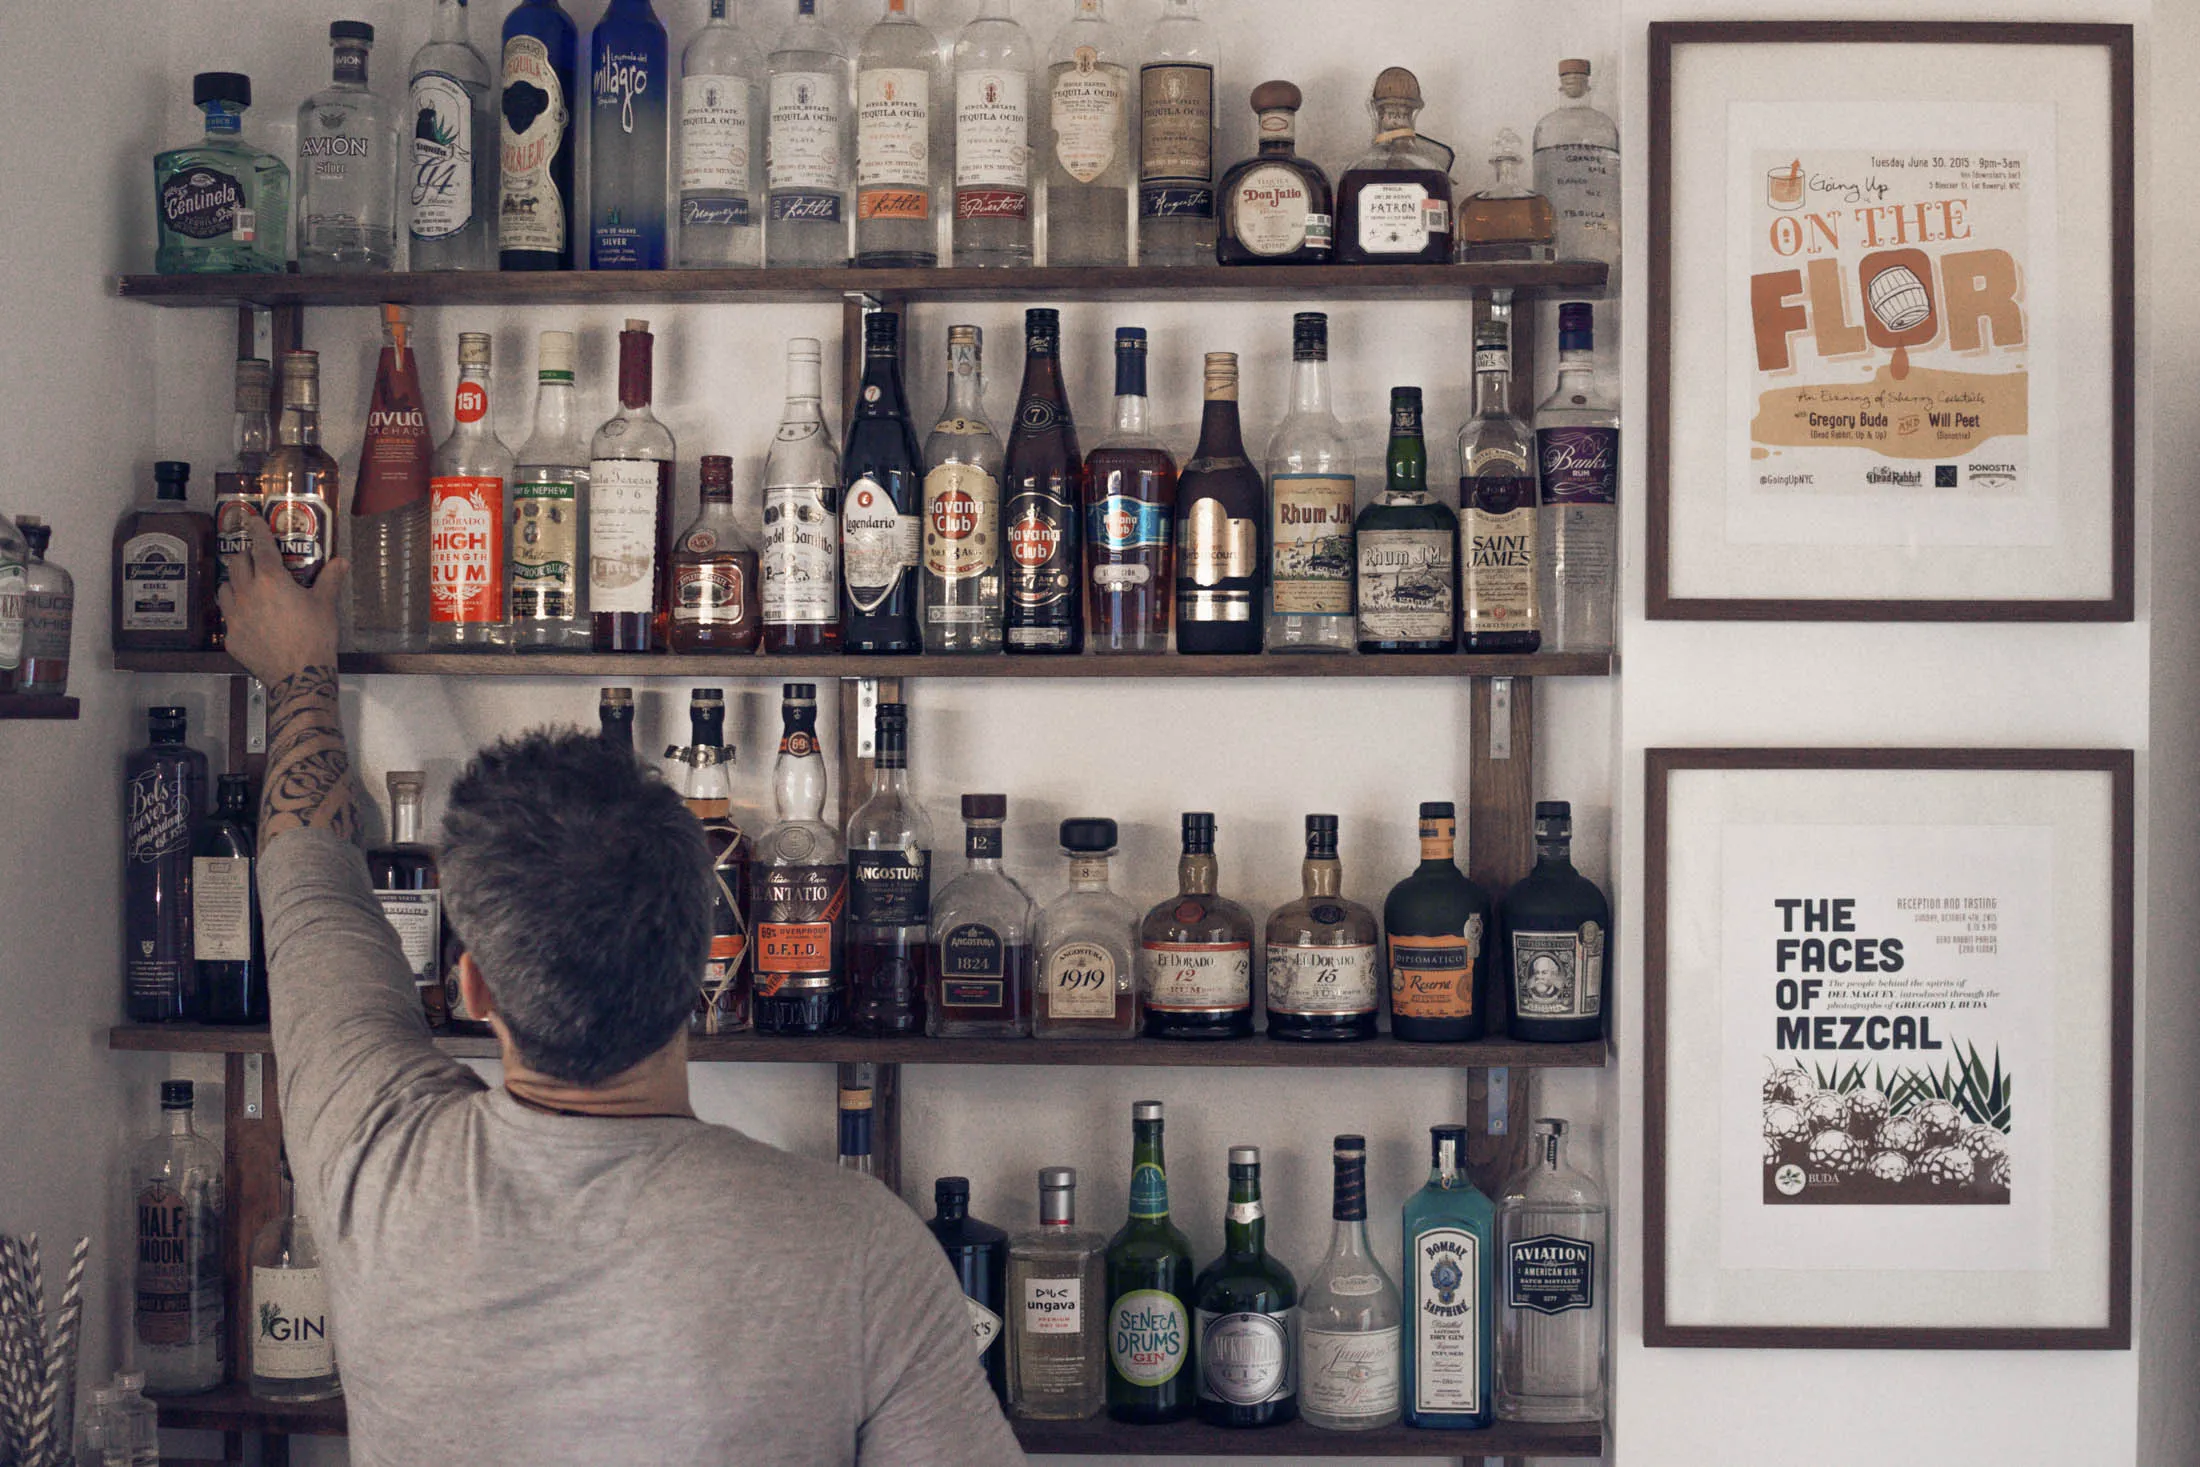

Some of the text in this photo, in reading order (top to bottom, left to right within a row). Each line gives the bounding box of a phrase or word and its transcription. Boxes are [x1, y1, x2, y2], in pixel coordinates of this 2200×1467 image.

[593, 44, 648, 134] milagro
[1054, 89, 1091, 98] TEQUILA
[683, 117, 745, 127] TEQUILA OCHO
[773, 113, 838, 123] TEQUILA OCHO
[861, 109, 926, 119] TEQUILA OCHO
[959, 113, 1024, 123] TEQUILA OCHO
[1871, 156, 1904, 169] Tuesday
[1908, 157, 1929, 168] June
[1950, 157, 1970, 168] 2015
[1808, 173, 1891, 203] Going Up
[167, 182, 236, 220] Centinela
[1243, 187, 1301, 208] Don Julio
[1769, 198, 1972, 257] ON THE
[602, 238, 628, 247] SILVER
[457, 393, 482, 411] 151
[1874, 389, 1886, 408] of
[1888, 390, 1934, 412] Sherry
[369, 408, 424, 427] avuá
[1031, 409, 1042, 422] 7
[1809, 412, 1855, 430] Gregory
[1860, 412, 1888, 427] Buda
[1928, 412, 1951, 427] Will
[1955, 412, 1980, 428] Peet
[955, 420, 964, 430] 3
[1546, 443, 1608, 473] Banks
[1969, 464, 2017, 472] DONOSTIA
[1759, 474, 1813, 486] @GoingUpNYC
[1892, 470, 1921, 485] Rabbit
[532, 486, 567, 495] NEPHEW
[928, 498, 985, 514] Havana
[1281, 503, 1327, 524] Rhum
[846, 513, 896, 535] Legendario
[936, 515, 971, 532] Club
[432, 532, 487, 551] HIGH
[773, 527, 785, 544] del
[1008, 526, 1061, 542] Havana
[280, 541, 313, 554] INIE
[1015, 543, 1047, 559] Club
[1472, 535, 1529, 551] SAINT
[432, 553, 487, 562] STRENGTH
[1365, 546, 1410, 567] Rhum
[1467, 550, 1531, 568] JAMES
[432, 564, 487, 582] RUM
[129, 778, 169, 821] Bols
[972, 836, 988, 849] 12
[856, 865, 924, 882] ANGOSTURA
[1082, 868, 1090, 878] 8
[1897, 897, 1998, 909] RECEPTION AND TASTING
[1775, 898, 1855, 932] THE
[780, 927, 827, 935] OVERPROOF
[767, 943, 820, 956] O.F.T.D.
[951, 937, 995, 948] ANGOSTURA
[1059, 948, 1103, 962] ANGOSTURA
[1170, 953, 1214, 968] DORADO
[1311, 953, 1354, 968] DORADO
[1776, 937, 1905, 973] FACES
[957, 957, 990, 970] 1824
[1057, 968, 1105, 991] 1919
[1175, 968, 1196, 983] 12
[1316, 968, 1340, 984] 15
[1828, 978, 1967, 990] The people behind the spirits of
[1775, 978, 1823, 1010] OF
[1827, 990, 1849, 999] DEL
[1900, 990, 1949, 998] introduced
[1950, 990, 1984, 1000] through
[1986, 990, 2000, 998] the
[1826, 1001, 1988, 1011] photographs of GREGORY BUDA
[1776, 1015, 1942, 1050] MEZCAL
[1808, 1173, 1840, 1184] BUDA
[140, 1206, 183, 1237] HALF
[140, 1239, 184, 1263] MOON
[1425, 1240, 1468, 1261] BOMBAY
[1514, 1247, 1587, 1261] AVIATION
[1524, 1268, 1578, 1276] AMERICAN GIN
[1027, 1301, 1075, 1312] ungava
[1423, 1298, 1471, 1318] SAPPHIRE
[1120, 1306, 1177, 1331] SENECA
[269, 1315, 325, 1341] GIN
[1117, 1331, 1180, 1358] DRUMS
[1132, 1351, 1166, 1366] GIN
